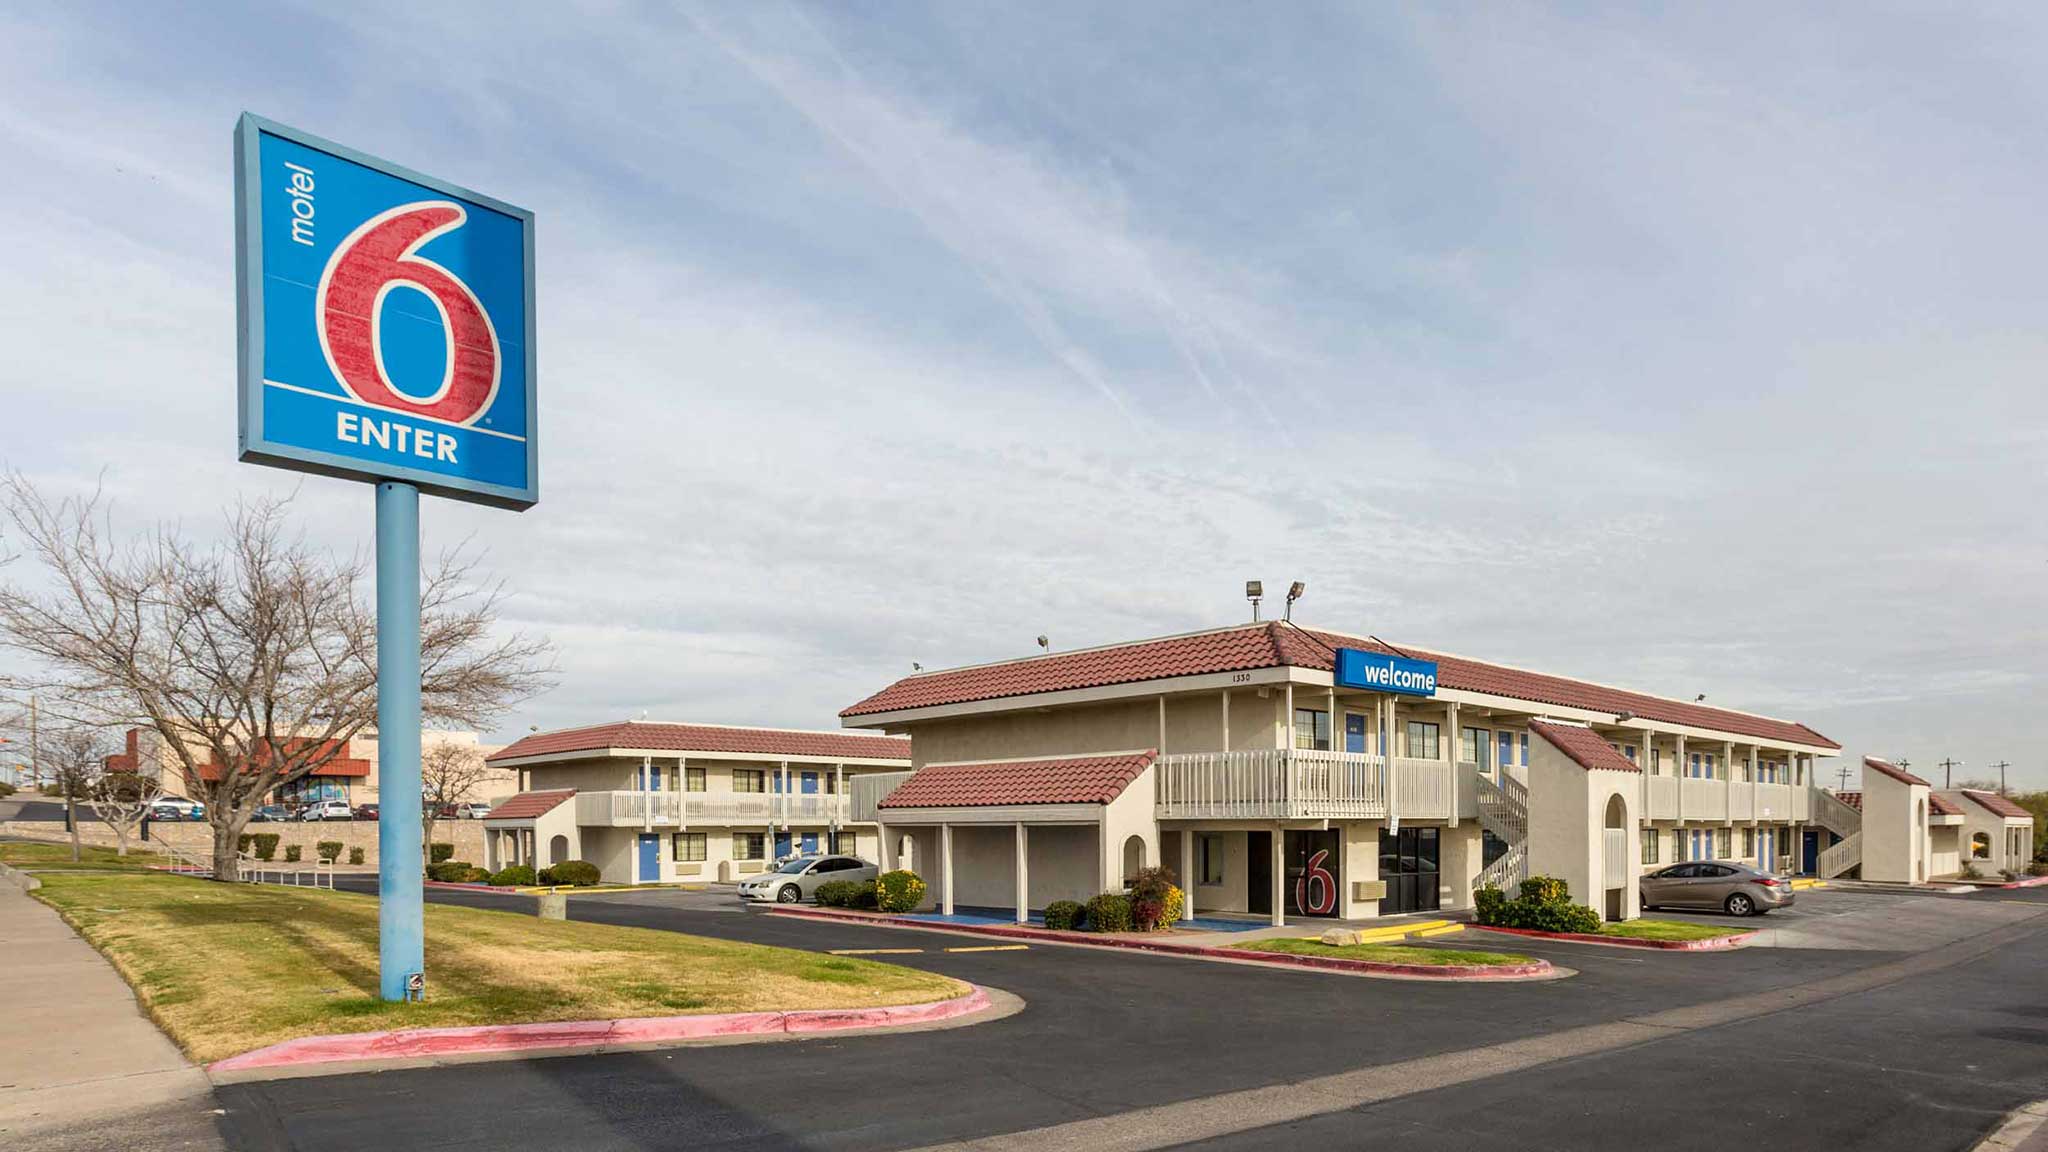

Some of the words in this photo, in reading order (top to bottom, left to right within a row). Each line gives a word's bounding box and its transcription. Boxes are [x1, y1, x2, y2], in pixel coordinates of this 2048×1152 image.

[284, 161, 315, 246] motel
[316, 200, 501, 427] 6
[337, 411, 459, 464] ENTER
[1232, 673, 1251, 683] 1330
[1364, 660, 1435, 691] welcome
[1295, 849, 1337, 915] 6
